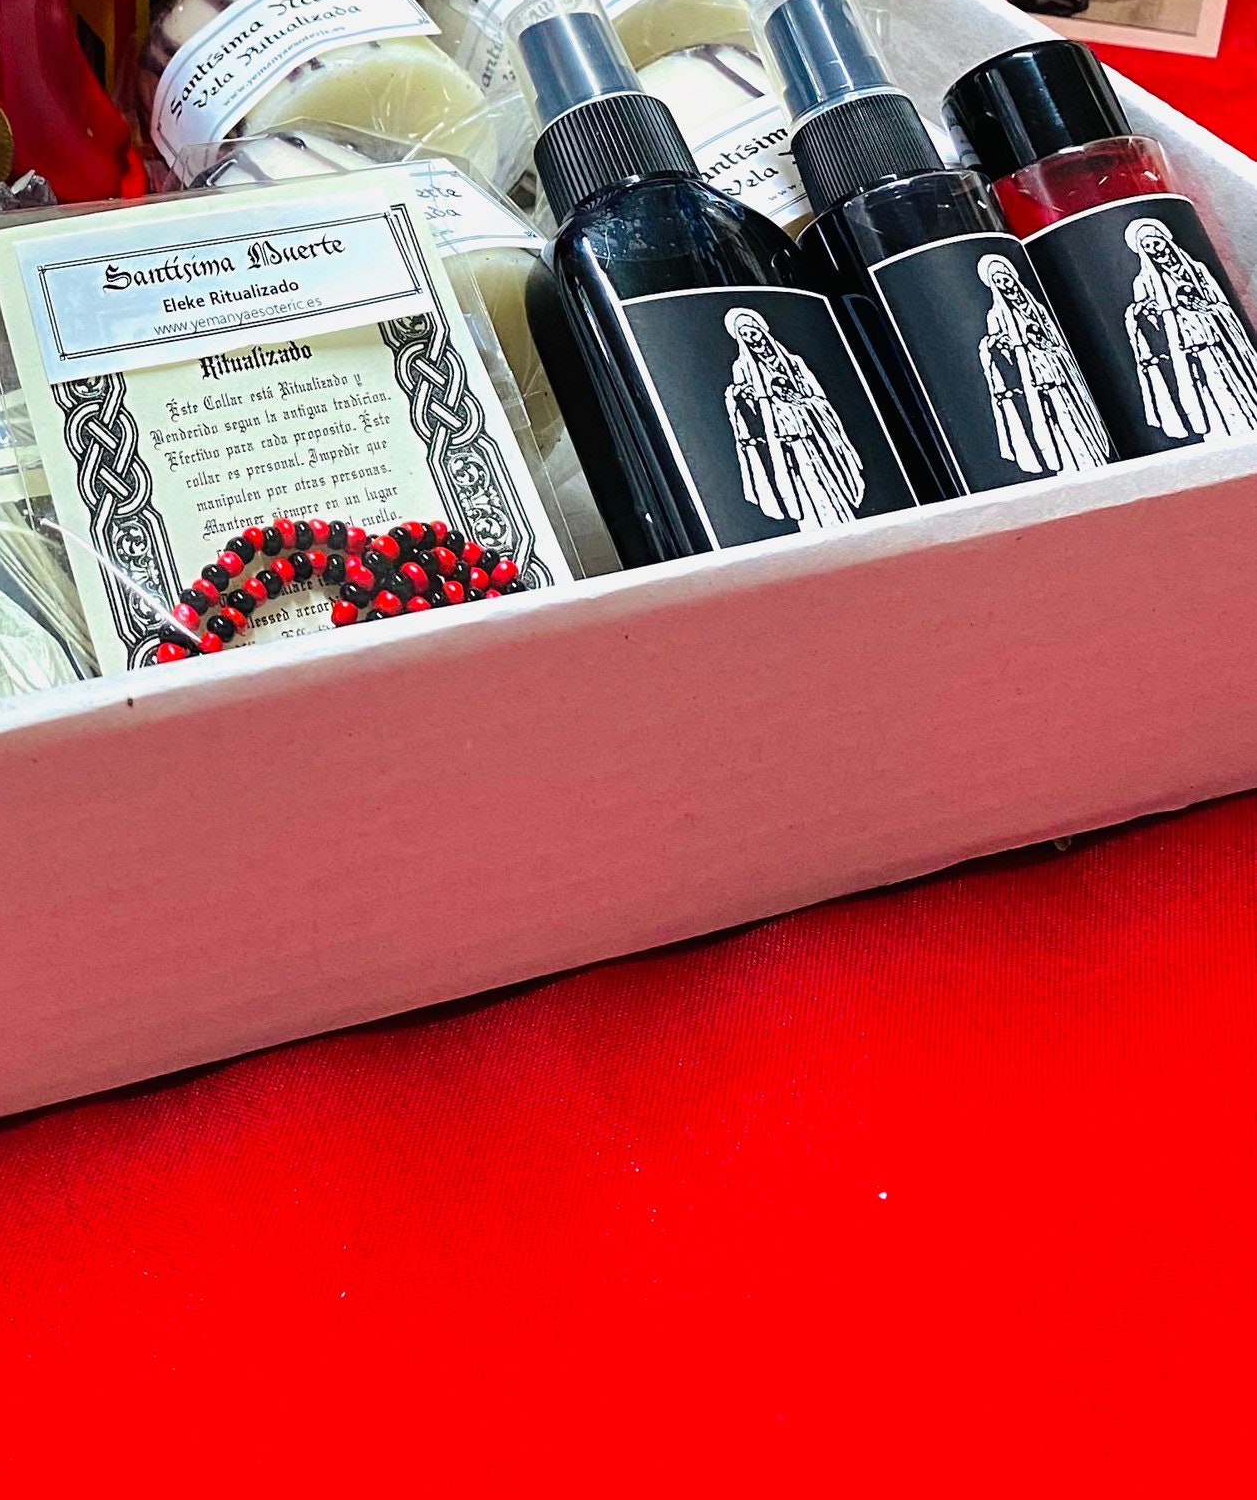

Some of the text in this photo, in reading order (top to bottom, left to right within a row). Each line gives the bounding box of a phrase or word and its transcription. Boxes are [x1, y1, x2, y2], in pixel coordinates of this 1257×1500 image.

[192, 3, 362, 109] Vela Ritualizada
[722, 167, 779, 196] Vela
[246, 233, 346, 271] Muerte
[162, 278, 299, 313] Eleke Ritualizado
[153, 295, 323, 336] www.yemanyaesoteric.es
[198, 340, 313, 381] Ritualizado
[203, 374, 349, 411] Collar Ritualizado
[224, 402, 329, 434] segun antigua
[164, 446, 221, 473] Efectivo
[185, 442, 361, 489] collar personal. Impedir
[196, 462, 393, 513] manipulen otras personas.
[202, 512, 265, 541] Mantener
